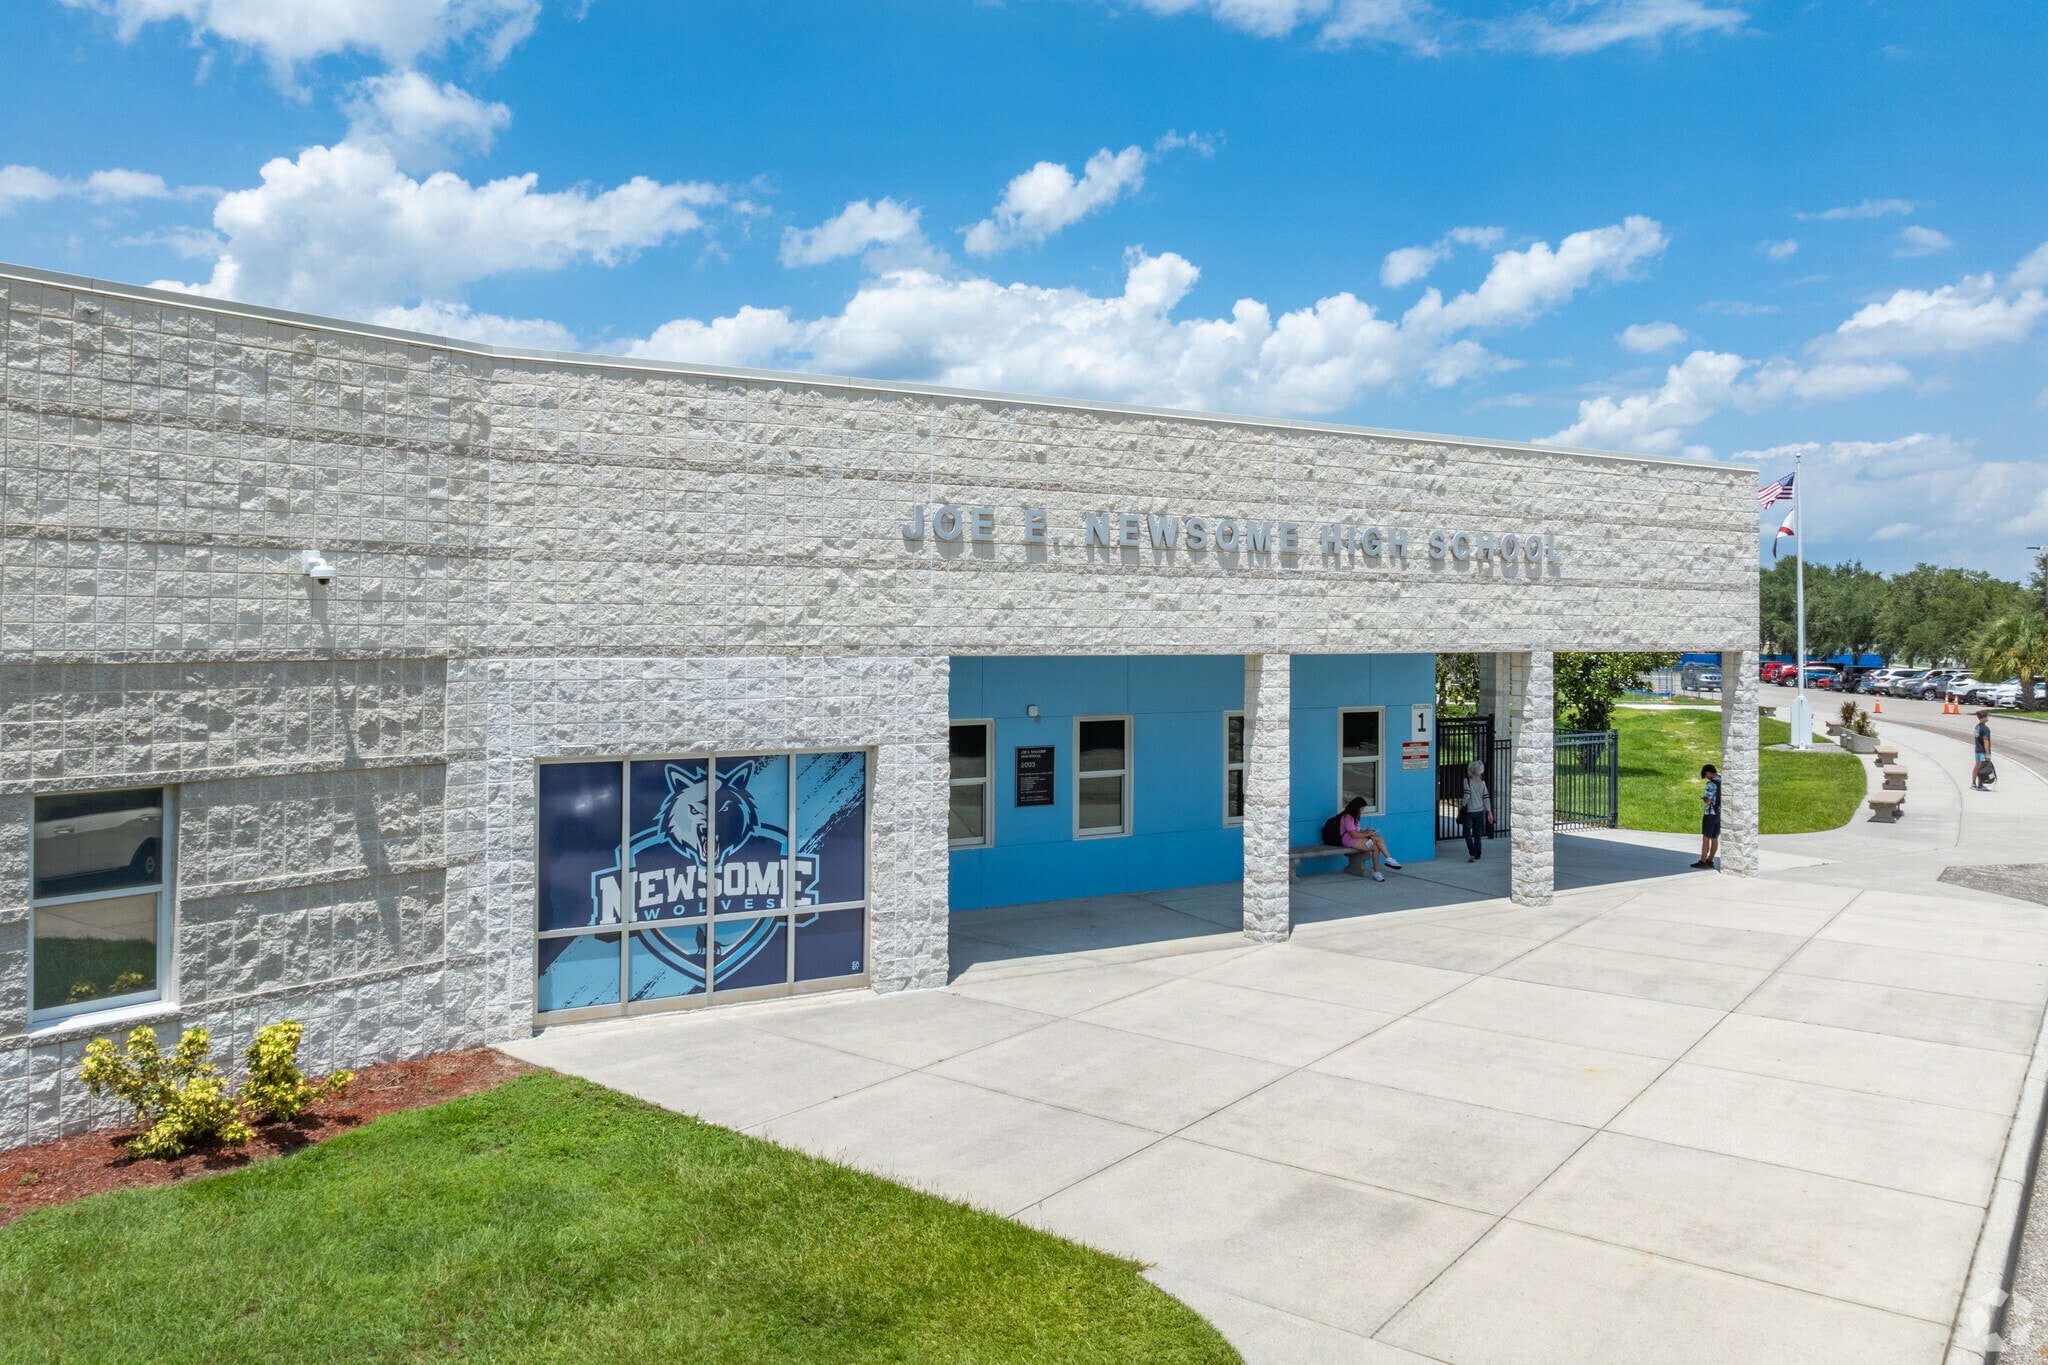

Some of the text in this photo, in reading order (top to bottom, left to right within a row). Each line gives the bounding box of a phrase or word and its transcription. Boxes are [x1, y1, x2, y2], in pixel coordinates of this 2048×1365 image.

[902, 504, 1562, 563] JOE E. NEWSOME HIGH SCHOOL
[1418, 712, 1426, 732] 1
[599, 858, 813, 925] NEWSOME
[643, 898, 776, 921] WOLVES
